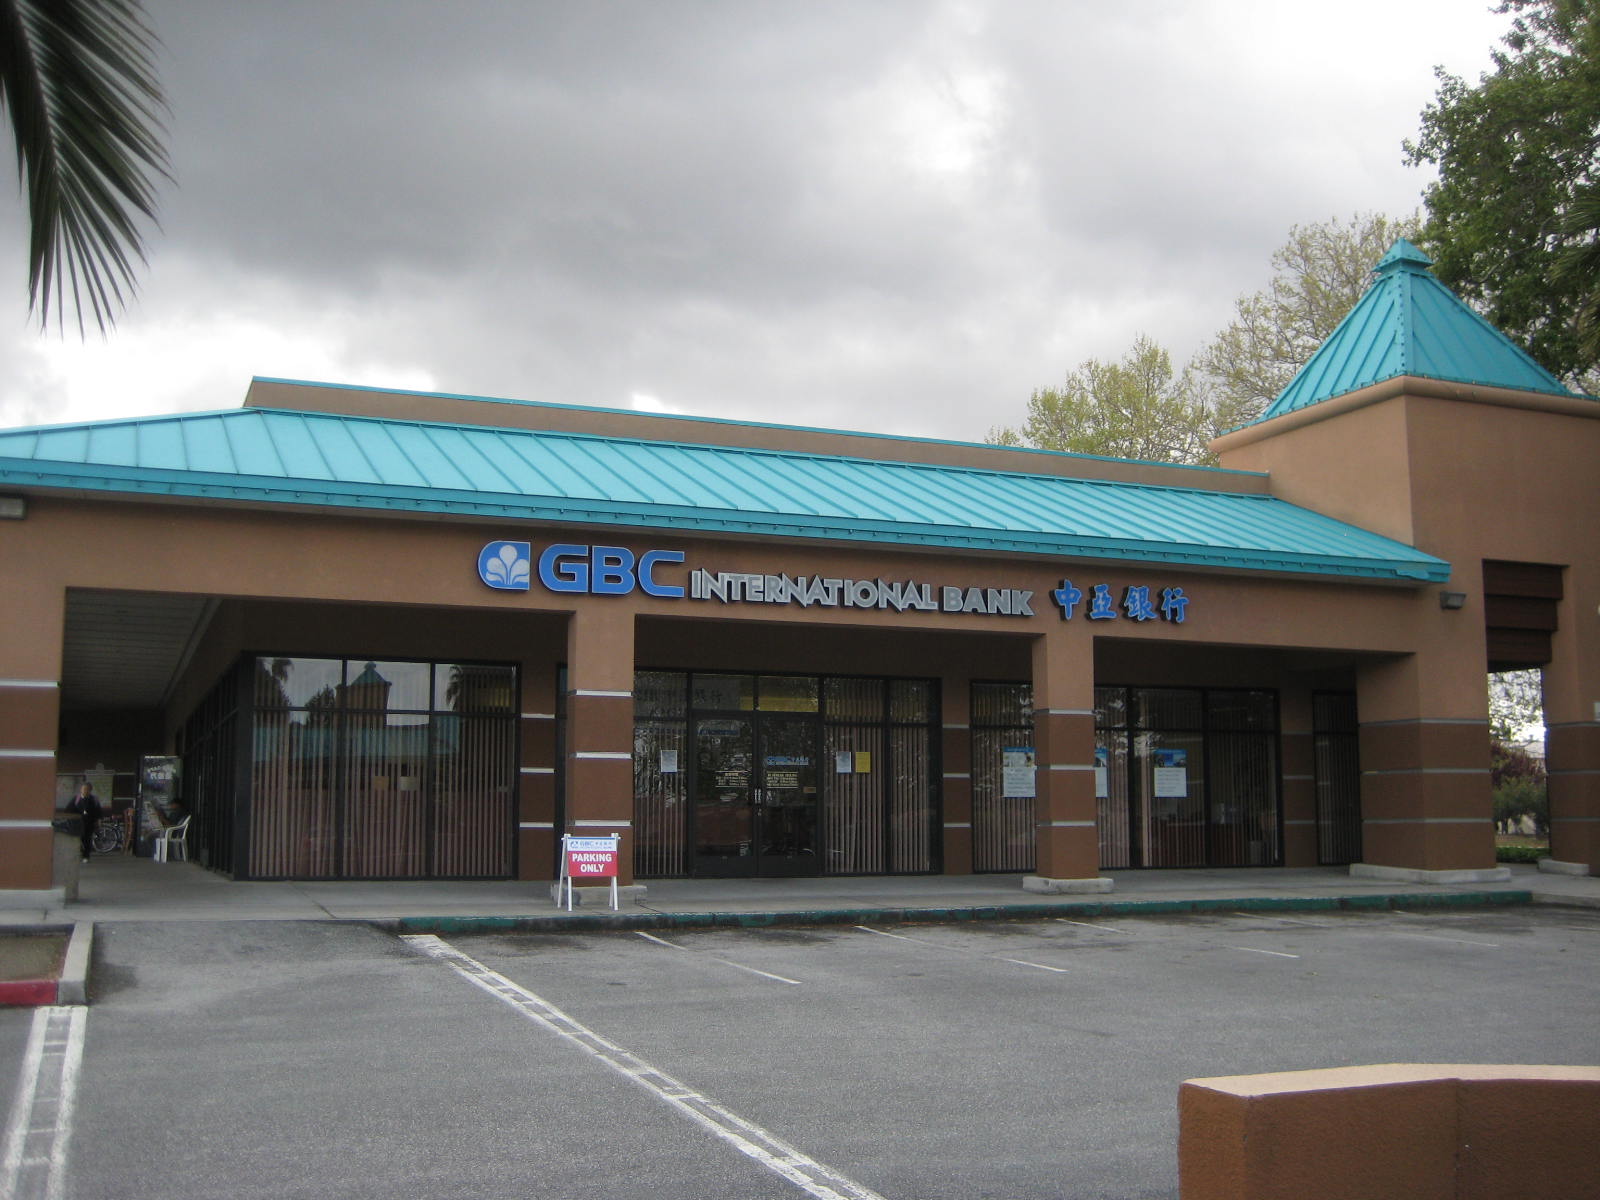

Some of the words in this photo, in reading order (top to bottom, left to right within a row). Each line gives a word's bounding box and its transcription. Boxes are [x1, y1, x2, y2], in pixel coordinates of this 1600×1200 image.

[539, 543, 686, 598] GBC
[690, 568, 938, 612] INTERNATIONAL
[942, 585, 1035, 617] BANK
[1054, 578, 1190, 623] 中亞銀行
[572, 853, 612, 862] PARKING
[580, 863, 604, 873] ONLY
